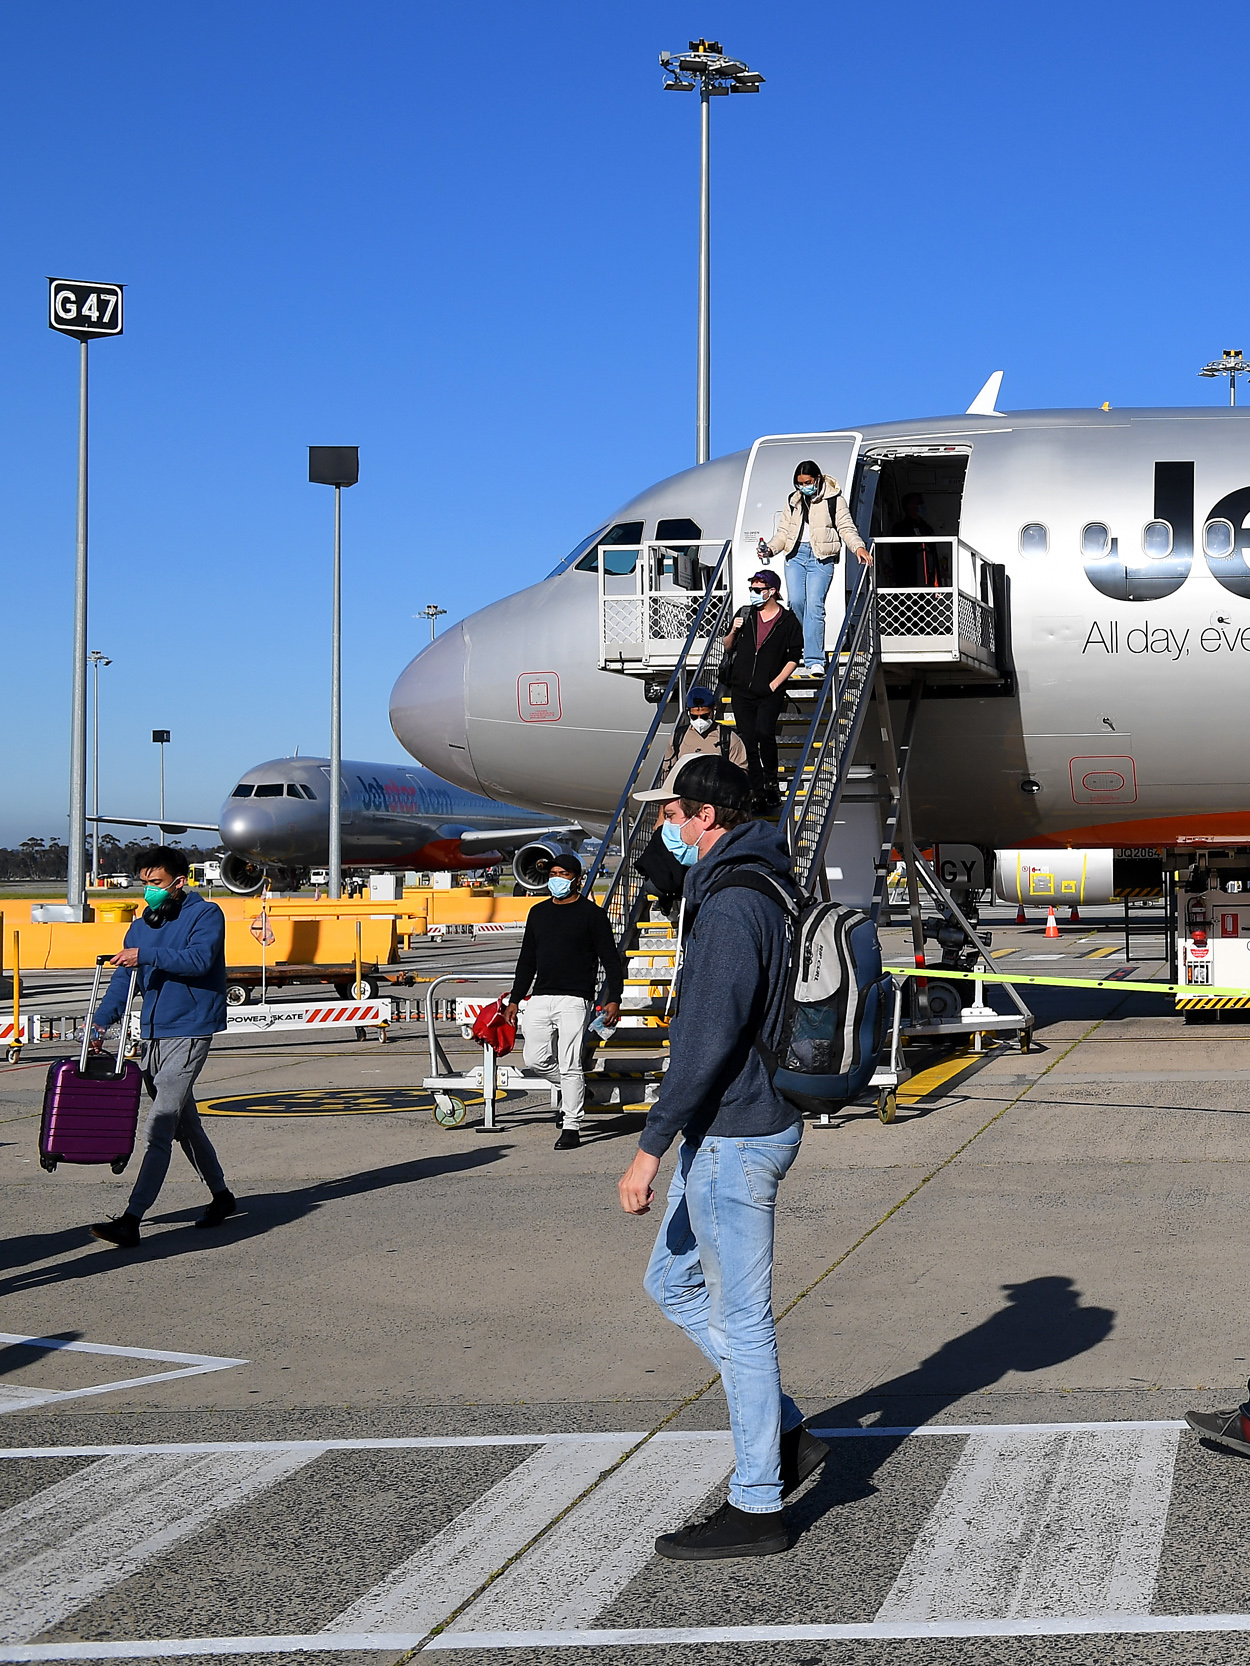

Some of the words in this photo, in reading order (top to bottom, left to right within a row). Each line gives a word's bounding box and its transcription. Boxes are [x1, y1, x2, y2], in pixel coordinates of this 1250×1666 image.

[55, 290, 118, 323] G47
[1082, 620, 1119, 654] All
[1126, 621, 1190, 661] day,
[941, 860, 977, 883] GY
[227, 1015, 267, 1023] POWER
